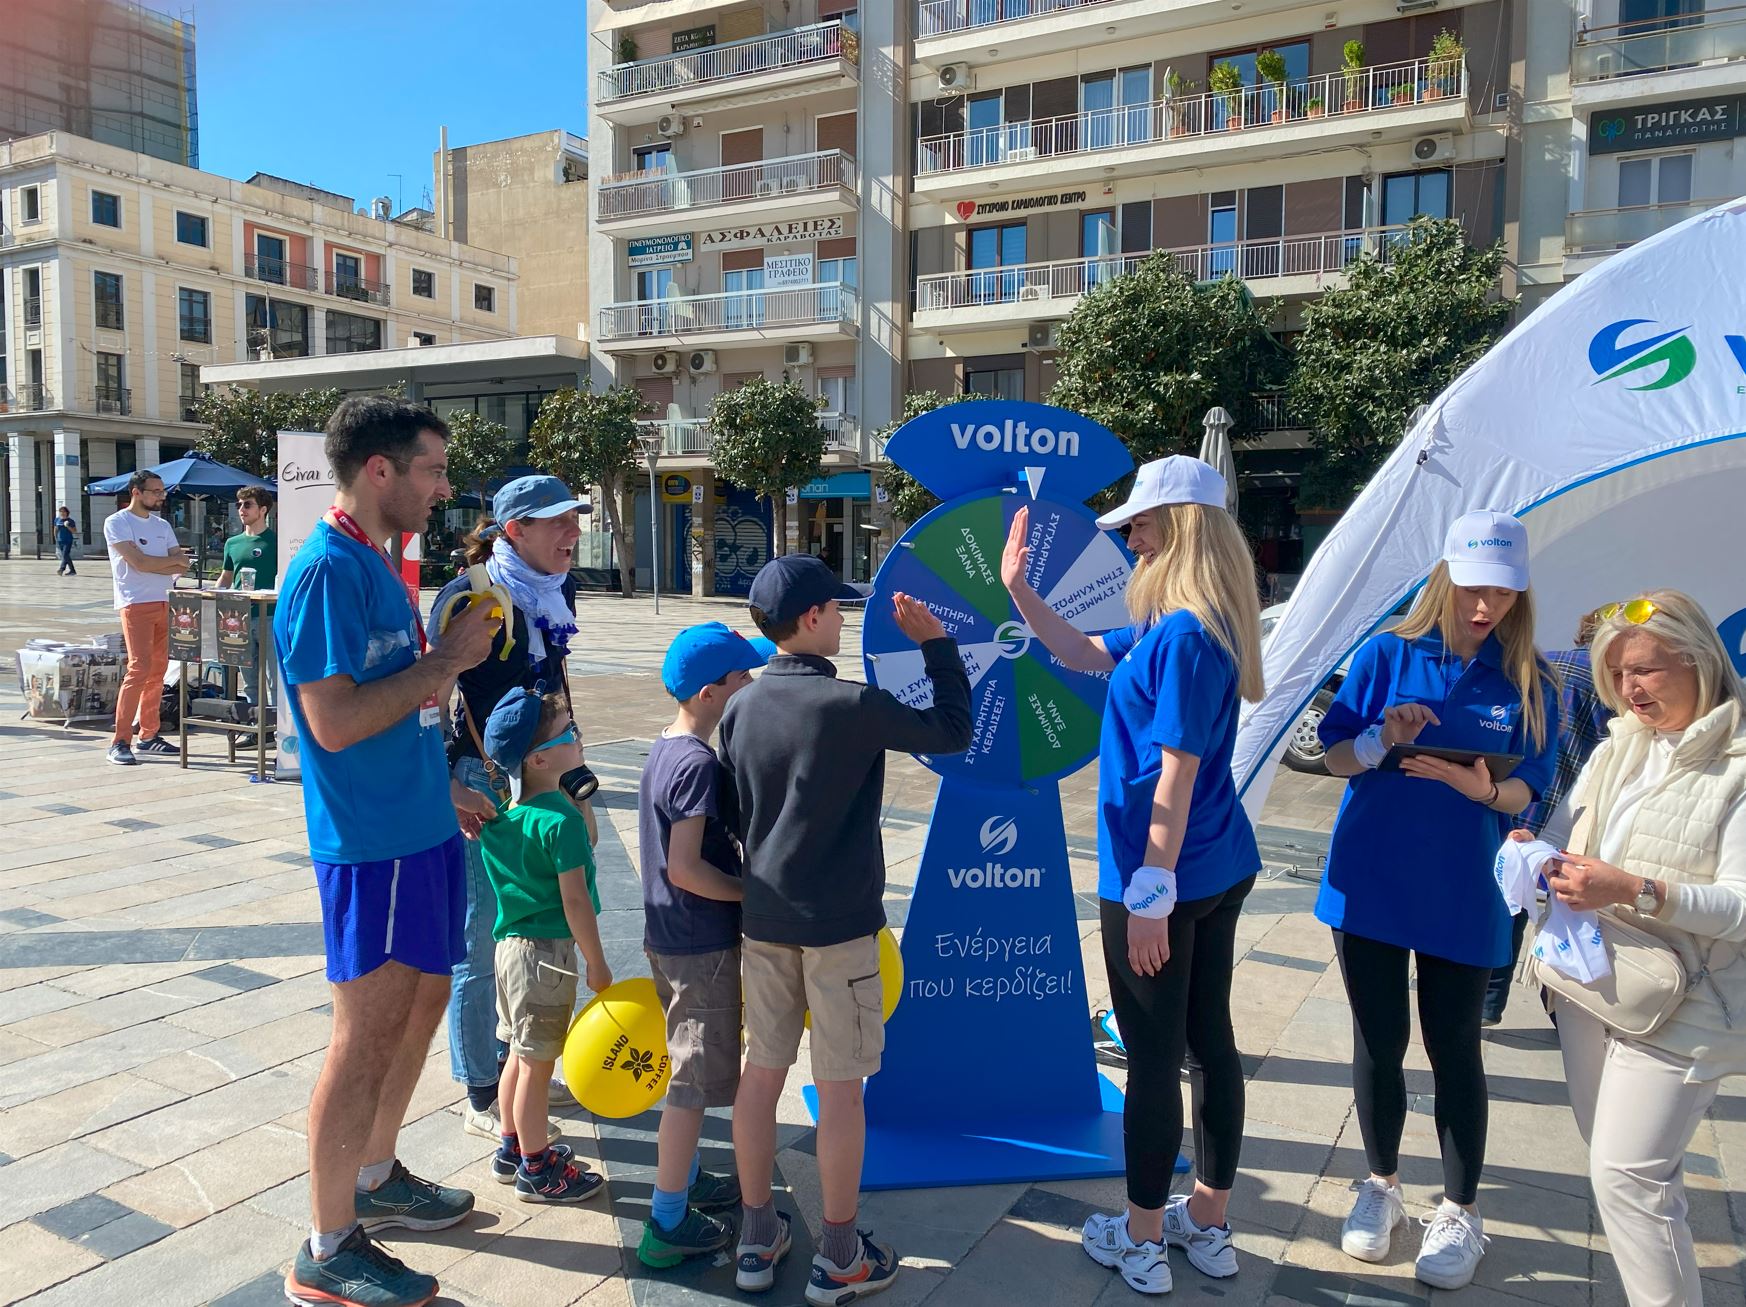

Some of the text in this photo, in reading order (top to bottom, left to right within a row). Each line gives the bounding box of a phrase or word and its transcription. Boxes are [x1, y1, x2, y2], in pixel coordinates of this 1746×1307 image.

[1634, 105, 1728, 129] ΤΡΙΓΚΑΣ
[1634, 122, 1728, 140] ΠΑΝΑΓΙΩΤΗΣ
[976, 190, 1087, 215] ΣΥΓΧΡΟΝΟ ΚΑΡΔΙΟΛΟΓΙΚΟ ΚΕΝΤΡΟ
[702, 217, 841, 245] ΑΣΦΑΛΕΙΕΣ
[766, 229, 842, 243] ΚΑΡΑΒΟΤΑΣ
[646, 243, 674, 254] ΙΑΤΡΕΙΟ
[766, 257, 811, 270] ΜΕΣΙΤΙΚΟ
[768, 267, 809, 279] ΓΡΑΦΕΙΟ
[950, 419, 1080, 457] volton
[960, 527, 995, 586] ΔΟΚΙΜΑΣΕ
[1031, 513, 1060, 591] ΣΥΓΧΑΡΗΤΗΡ
[1480, 538, 1512, 548] volton
[955, 547, 975, 580] ΞΑΝΑ
[1051, 566, 1125, 612] ΣΤΗΝ ΚΛΗΡΩΣ
[1062, 586, 1116, 620] ΣΥΜΜΕΤΟΧ
[965, 679, 998, 765] ΣΥΓΧΑΡΗΤΗΡΙΑ
[981, 695, 1006, 754] ΚΕΡΔΙΣΕΣ!
[1028, 693, 1061, 749] ΔΟΚΙΜΑΣΕ
[1047, 699, 1067, 732] ΞΑΝΑ
[1479, 719, 1513, 733] volton
[947, 863, 1042, 889] volton
[934, 927, 1052, 962] Ενέργεια
[909, 966, 1073, 1003] που κερδίζει!
[602, 1034, 629, 1071] ISLAND
[646, 1055, 668, 1091] COFFEE
